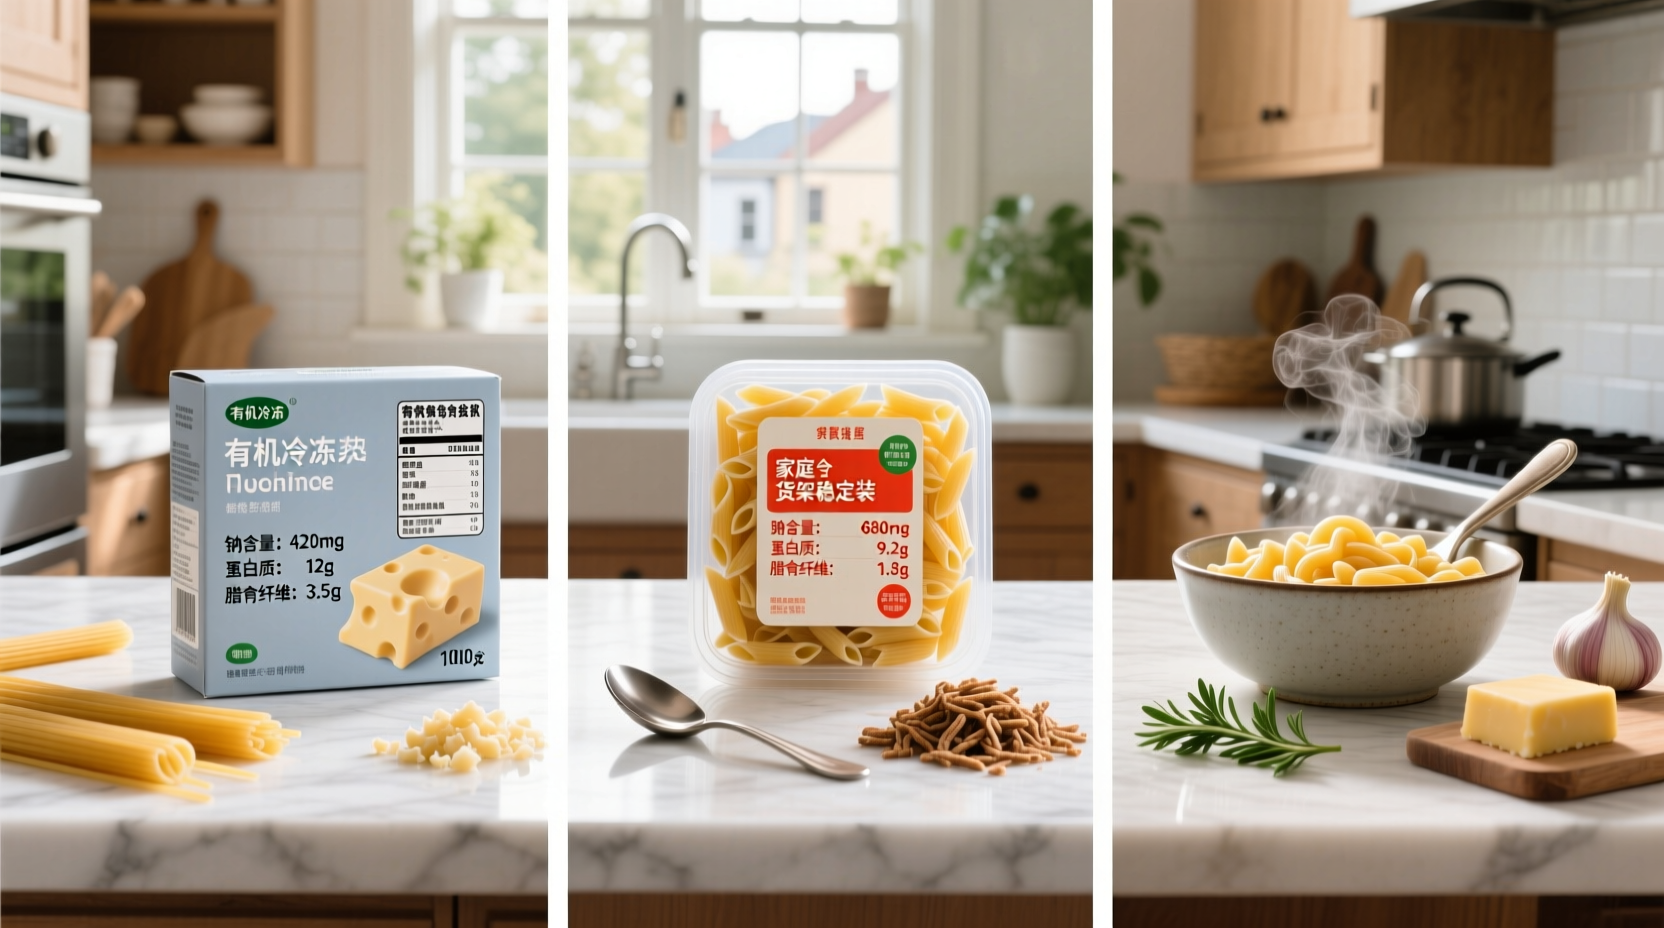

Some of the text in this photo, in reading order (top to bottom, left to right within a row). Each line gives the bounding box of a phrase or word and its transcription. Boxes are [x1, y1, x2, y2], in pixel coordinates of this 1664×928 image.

[289, 533, 344, 552] 420mg
[876, 541, 909, 560] 9.2g
[306, 558, 334, 577] 12g
[306, 583, 342, 602] 3.5g
